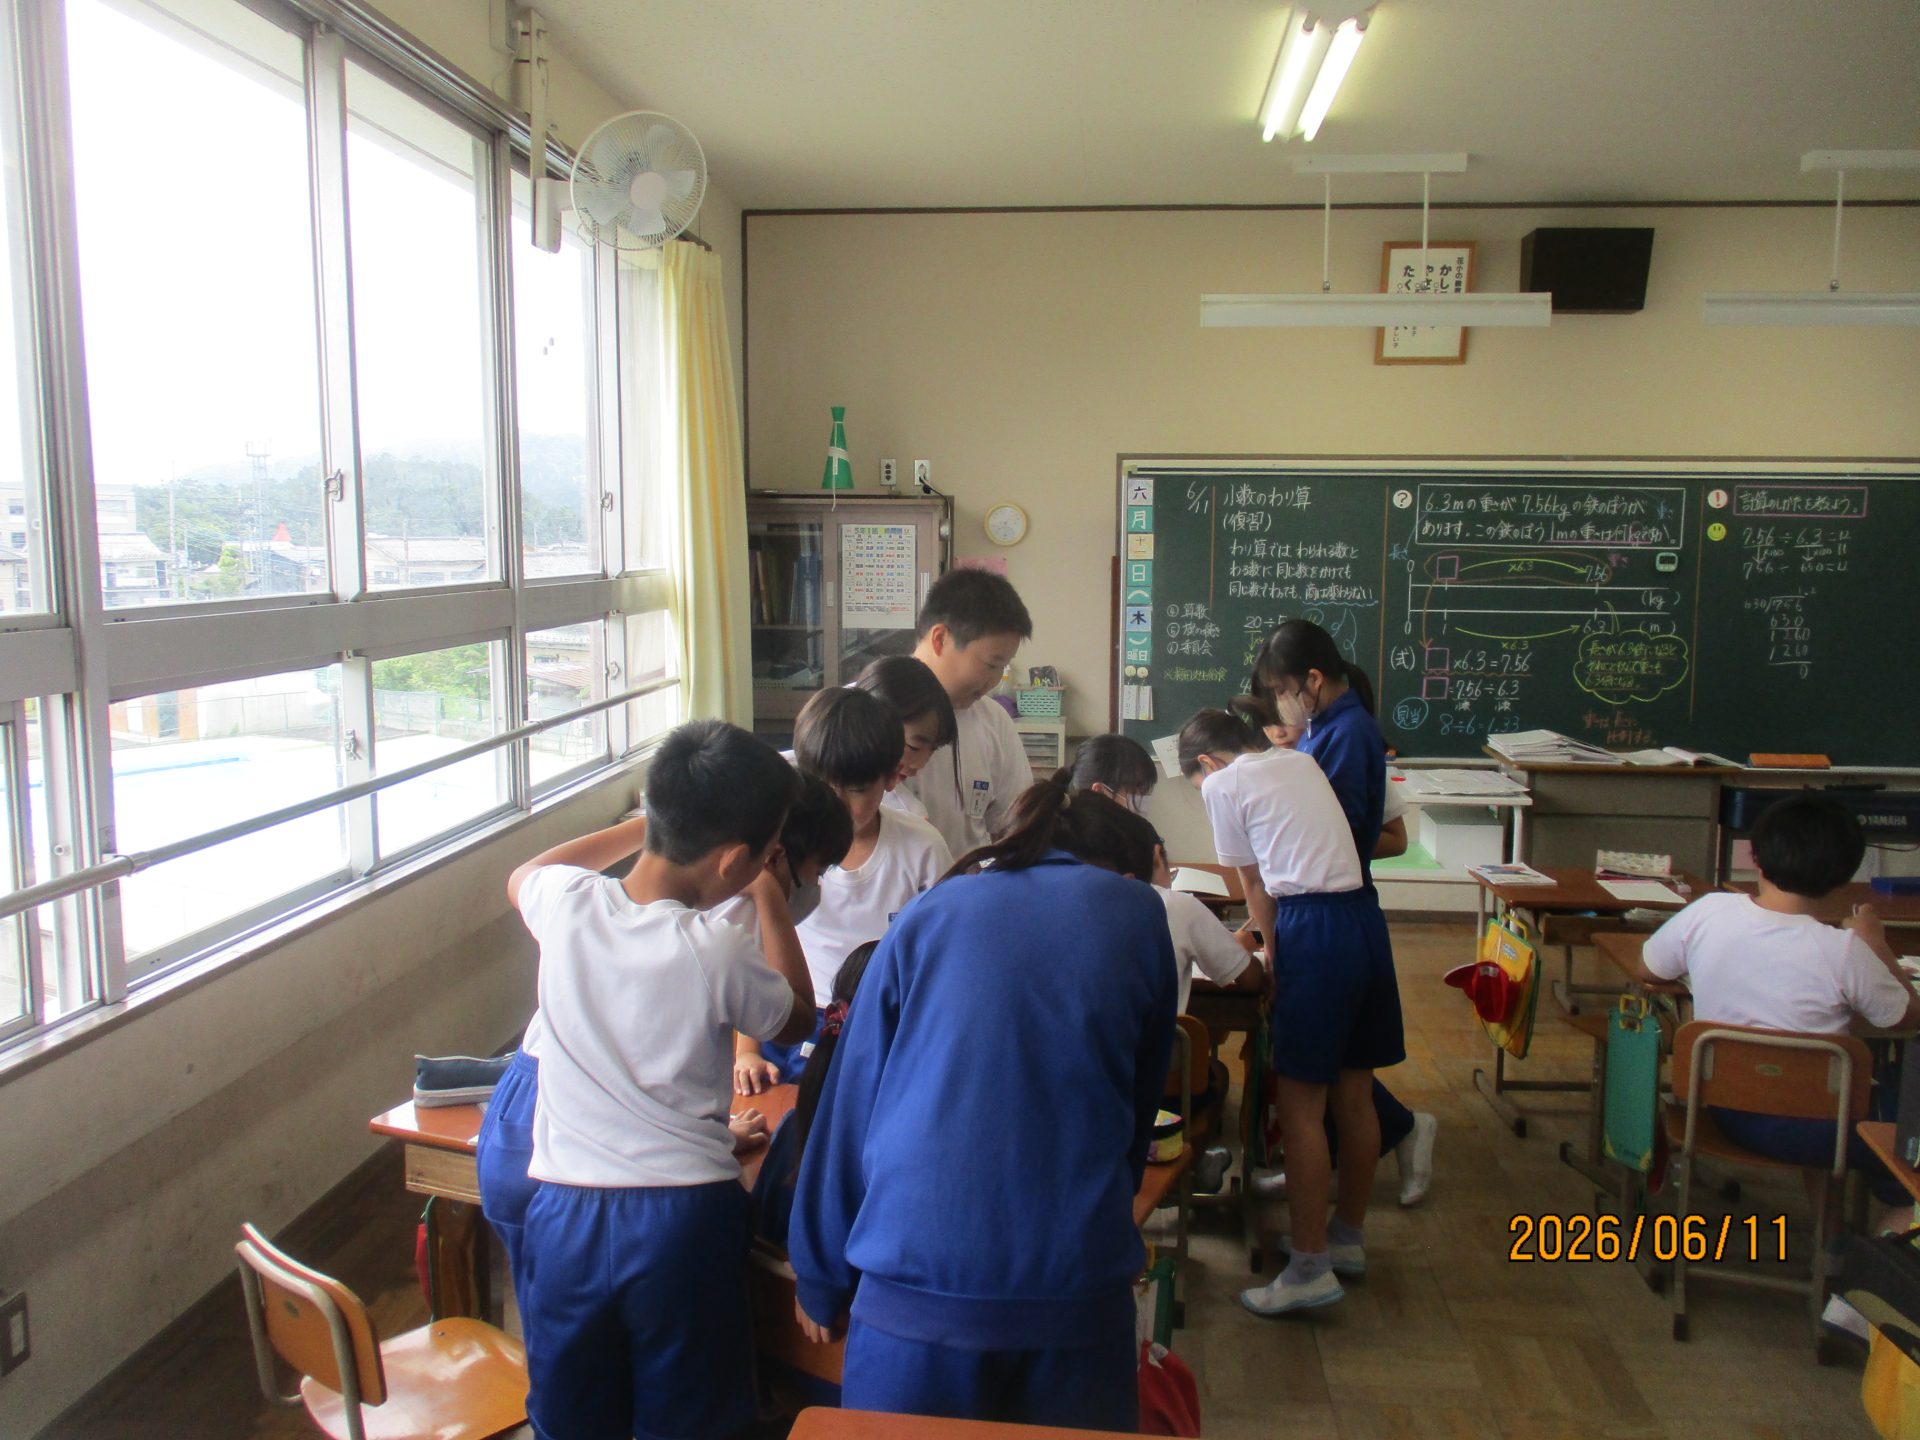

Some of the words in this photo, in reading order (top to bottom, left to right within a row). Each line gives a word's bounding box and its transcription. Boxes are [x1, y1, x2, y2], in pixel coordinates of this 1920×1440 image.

[1187, 481, 1209, 514] 6/11
[1223, 483, 1312, 511] 小数のわり算
[1223, 510, 1272, 533] (復習)
[1585, 564, 1608, 582] 7.56
[1583, 619, 1606, 633] 6.3
[1390, 645, 1416, 671] (式)
[1868, 815, 1908, 825] YAMAHA
